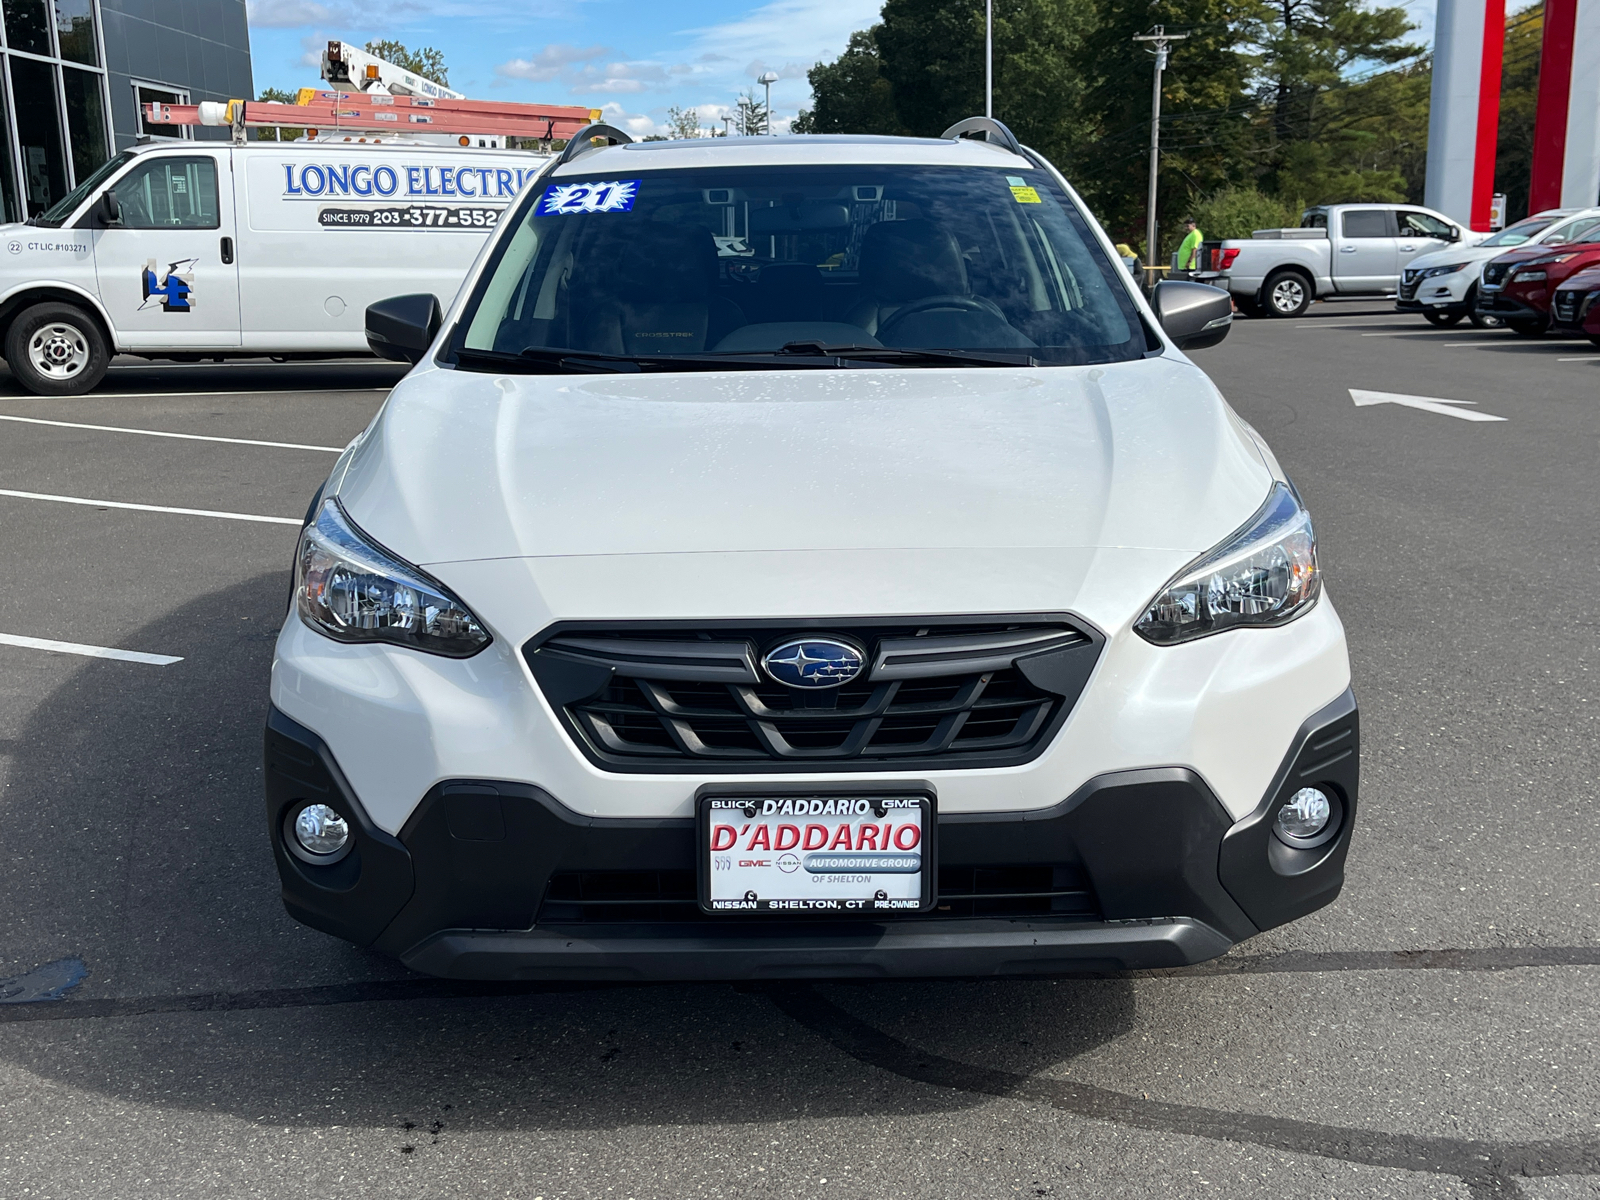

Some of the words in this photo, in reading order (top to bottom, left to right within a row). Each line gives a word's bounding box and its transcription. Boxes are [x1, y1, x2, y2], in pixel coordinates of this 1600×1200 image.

[282, 164, 399, 197] LONGO
[560, 186, 614, 208] 21
[322, 213, 348, 223] SINCE
[350, 214, 370, 224] 1979
[10, 243, 20, 251] 22
[28, 242, 39, 251] CT
[711, 800, 756, 809] BUICK
[761, 799, 871, 816] D'ADDARIO
[881, 799, 920, 808] GMC
[710, 823, 922, 851] D'ADDARIO
[738, 859, 772, 867] GMC
[809, 858, 878, 868] AUTOMOTIVE
[880, 858, 918, 868] GROUP
[812, 875, 826, 883] OF
[827, 875, 872, 883] SHELTON
[712, 900, 757, 909] NISSAN
[768, 900, 842, 910] SHELTON,
[845, 900, 866, 908] CT
[874, 900, 920, 908] PRE-OWNED
